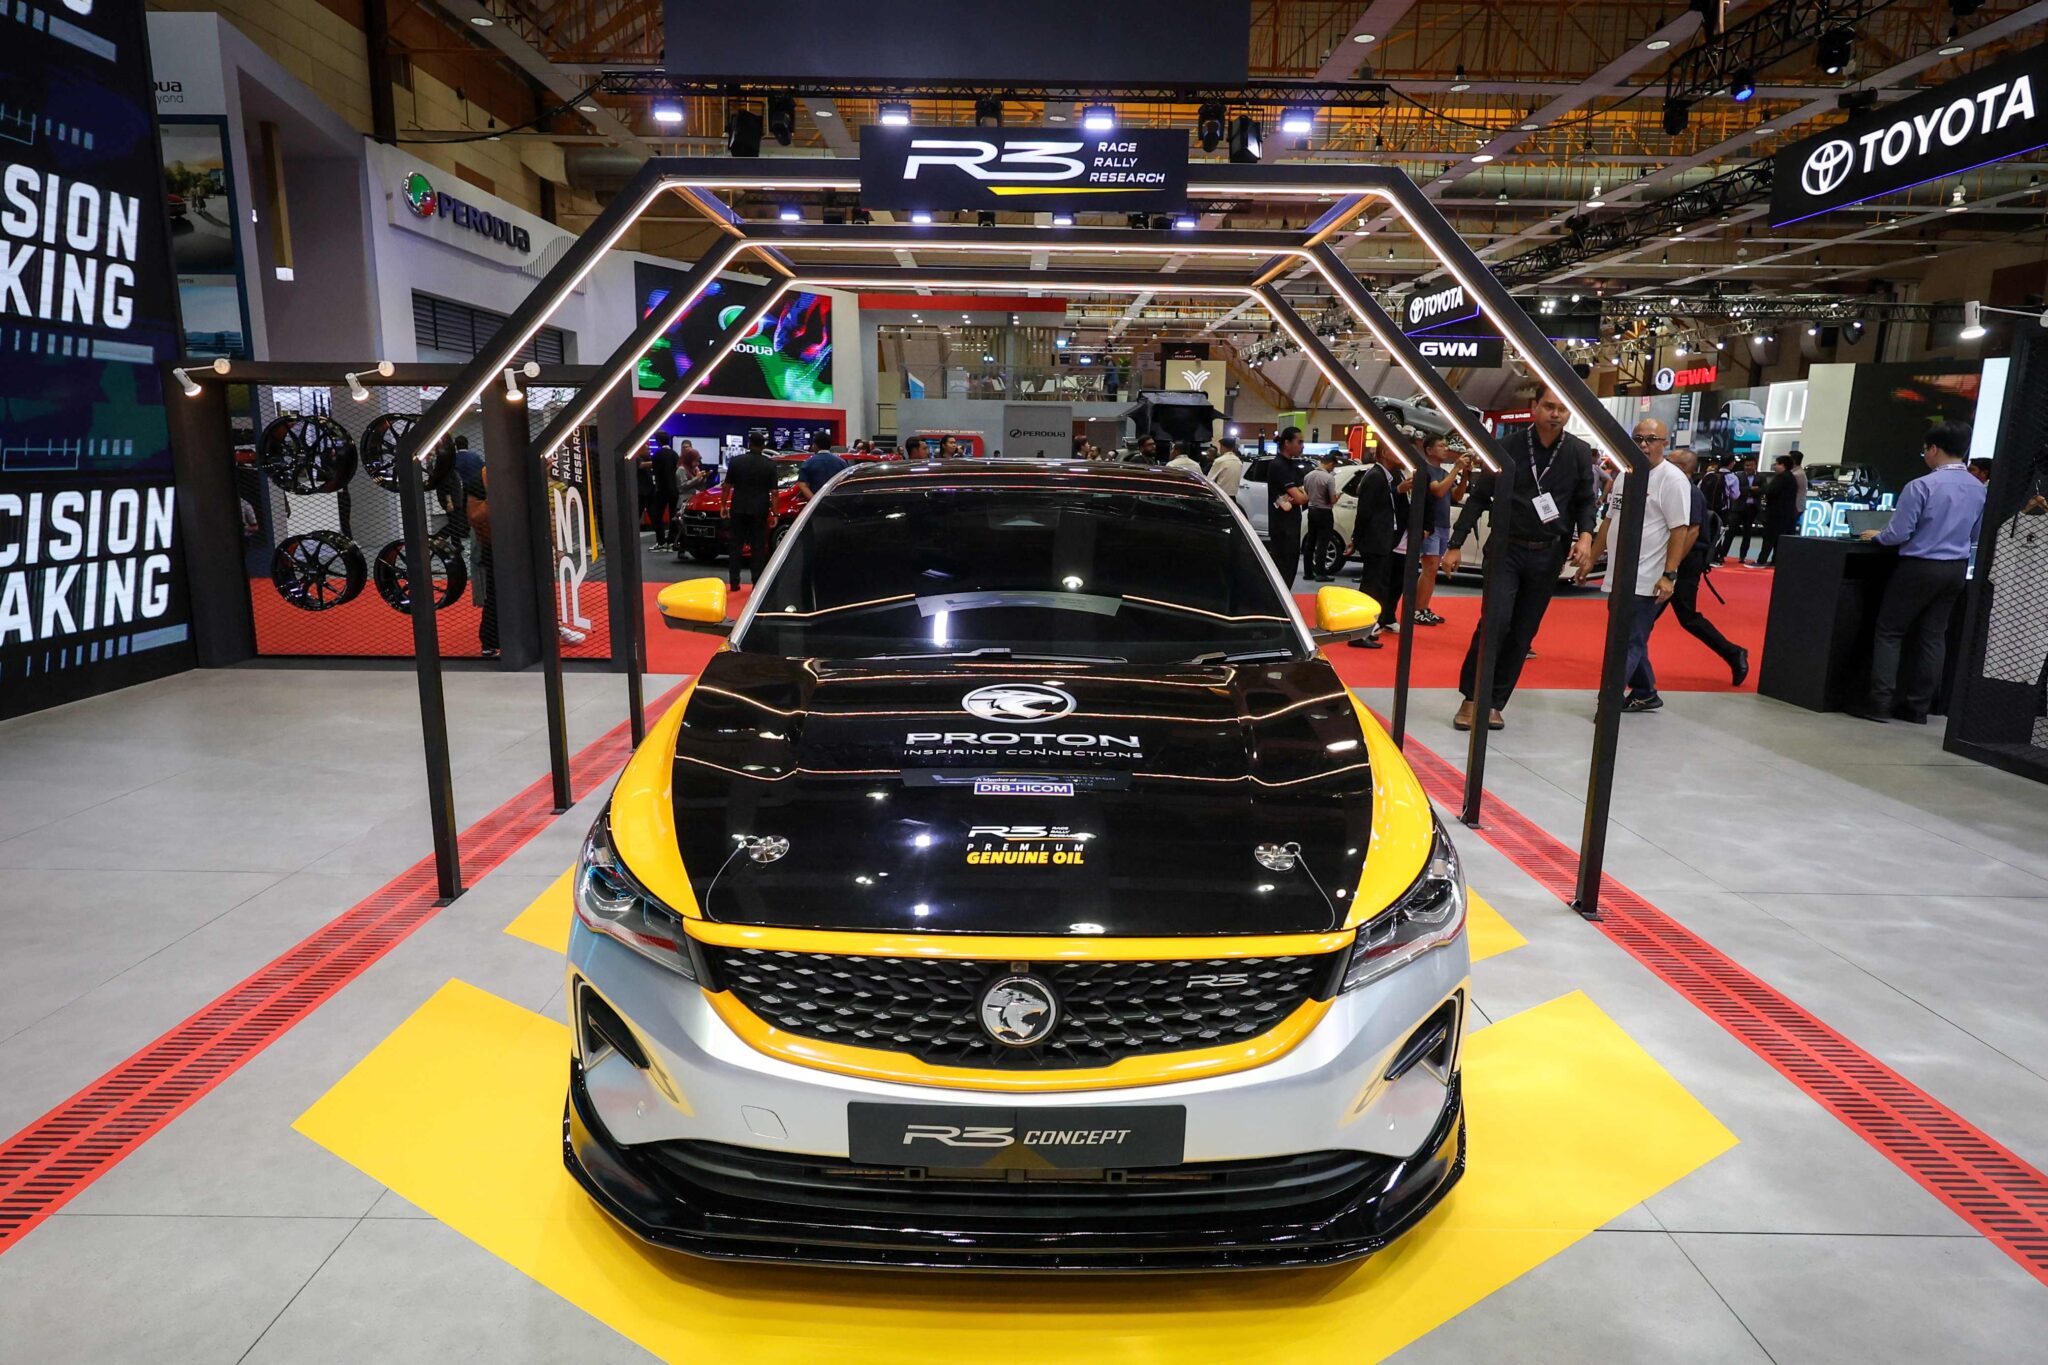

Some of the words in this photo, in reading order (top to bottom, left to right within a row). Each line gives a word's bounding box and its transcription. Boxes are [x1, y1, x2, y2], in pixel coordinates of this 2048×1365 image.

[1859, 74, 2036, 174] TOYOTA
[1097, 142, 1137, 153] RACE
[903, 140, 1085, 181] R3
[1093, 157, 1138, 168] RALLY
[1089, 172, 1165, 183] RESEARCH
[1424, 285, 1464, 317] TOYOTA
[1419, 341, 1478, 357] GWM
[1674, 366, 1717, 387] GWM
[551, 448, 560, 477] RAC
[562, 443, 571, 480] RALLY
[572, 426, 583, 483] RESEARC
[905, 732, 1141, 748] PROTON
[1005, 749, 1143, 759] CONNECTIONS
[980, 784, 1068, 793] DRB-HICOM
[966, 843, 1084, 851] PREMIUM
[966, 851, 1048, 865] GENUINE
[1052, 852, 1084, 864] OIL
[902, 1124, 1015, 1148] R3
[1023, 1129, 1131, 1145] CONCEPT
